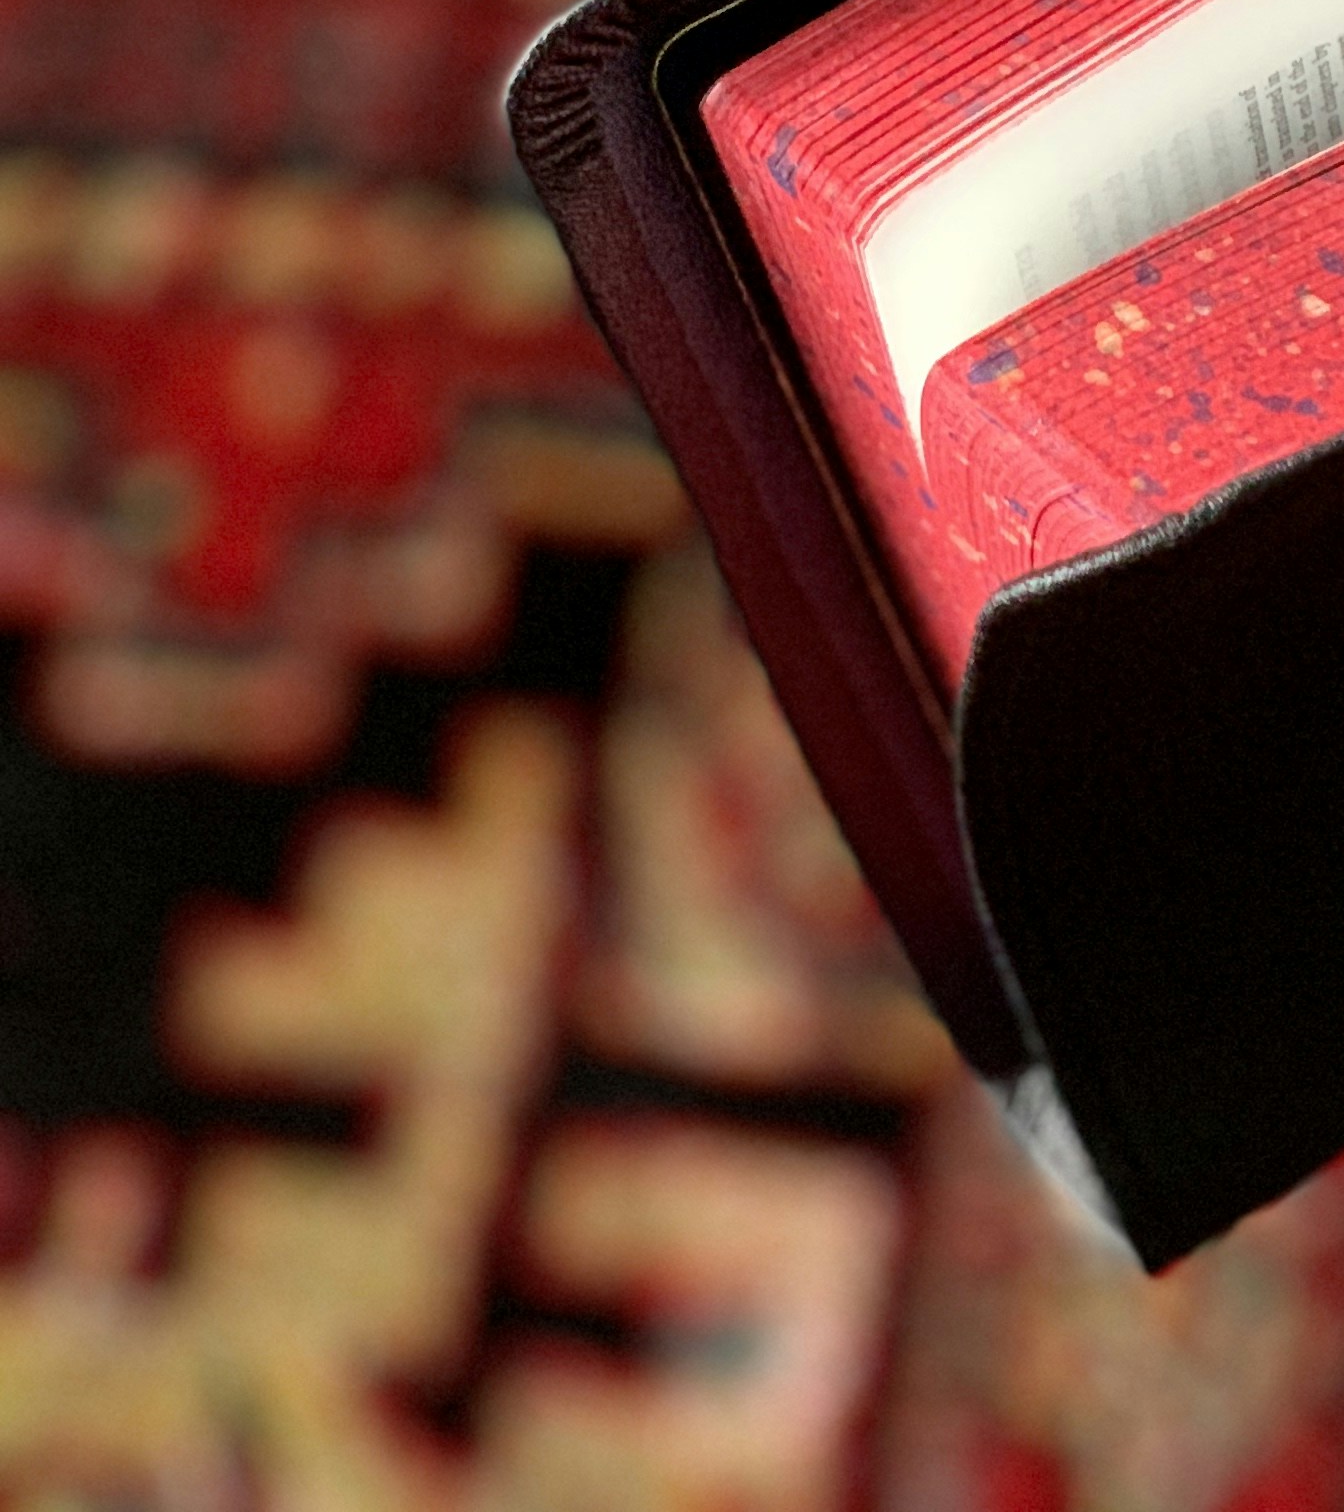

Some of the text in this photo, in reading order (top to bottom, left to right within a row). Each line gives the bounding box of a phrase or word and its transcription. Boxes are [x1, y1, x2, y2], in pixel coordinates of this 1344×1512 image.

[1264, 71, 1281, 90] in
[1312, 42, 1331, 65] by
[1239, 86, 1257, 101] of
[1288, 57, 1318, 143] the end of the
[1317, 60, 1339, 114] chapters
[1246, 100, 1269, 168] translation
[1267, 88, 1292, 150] translated
